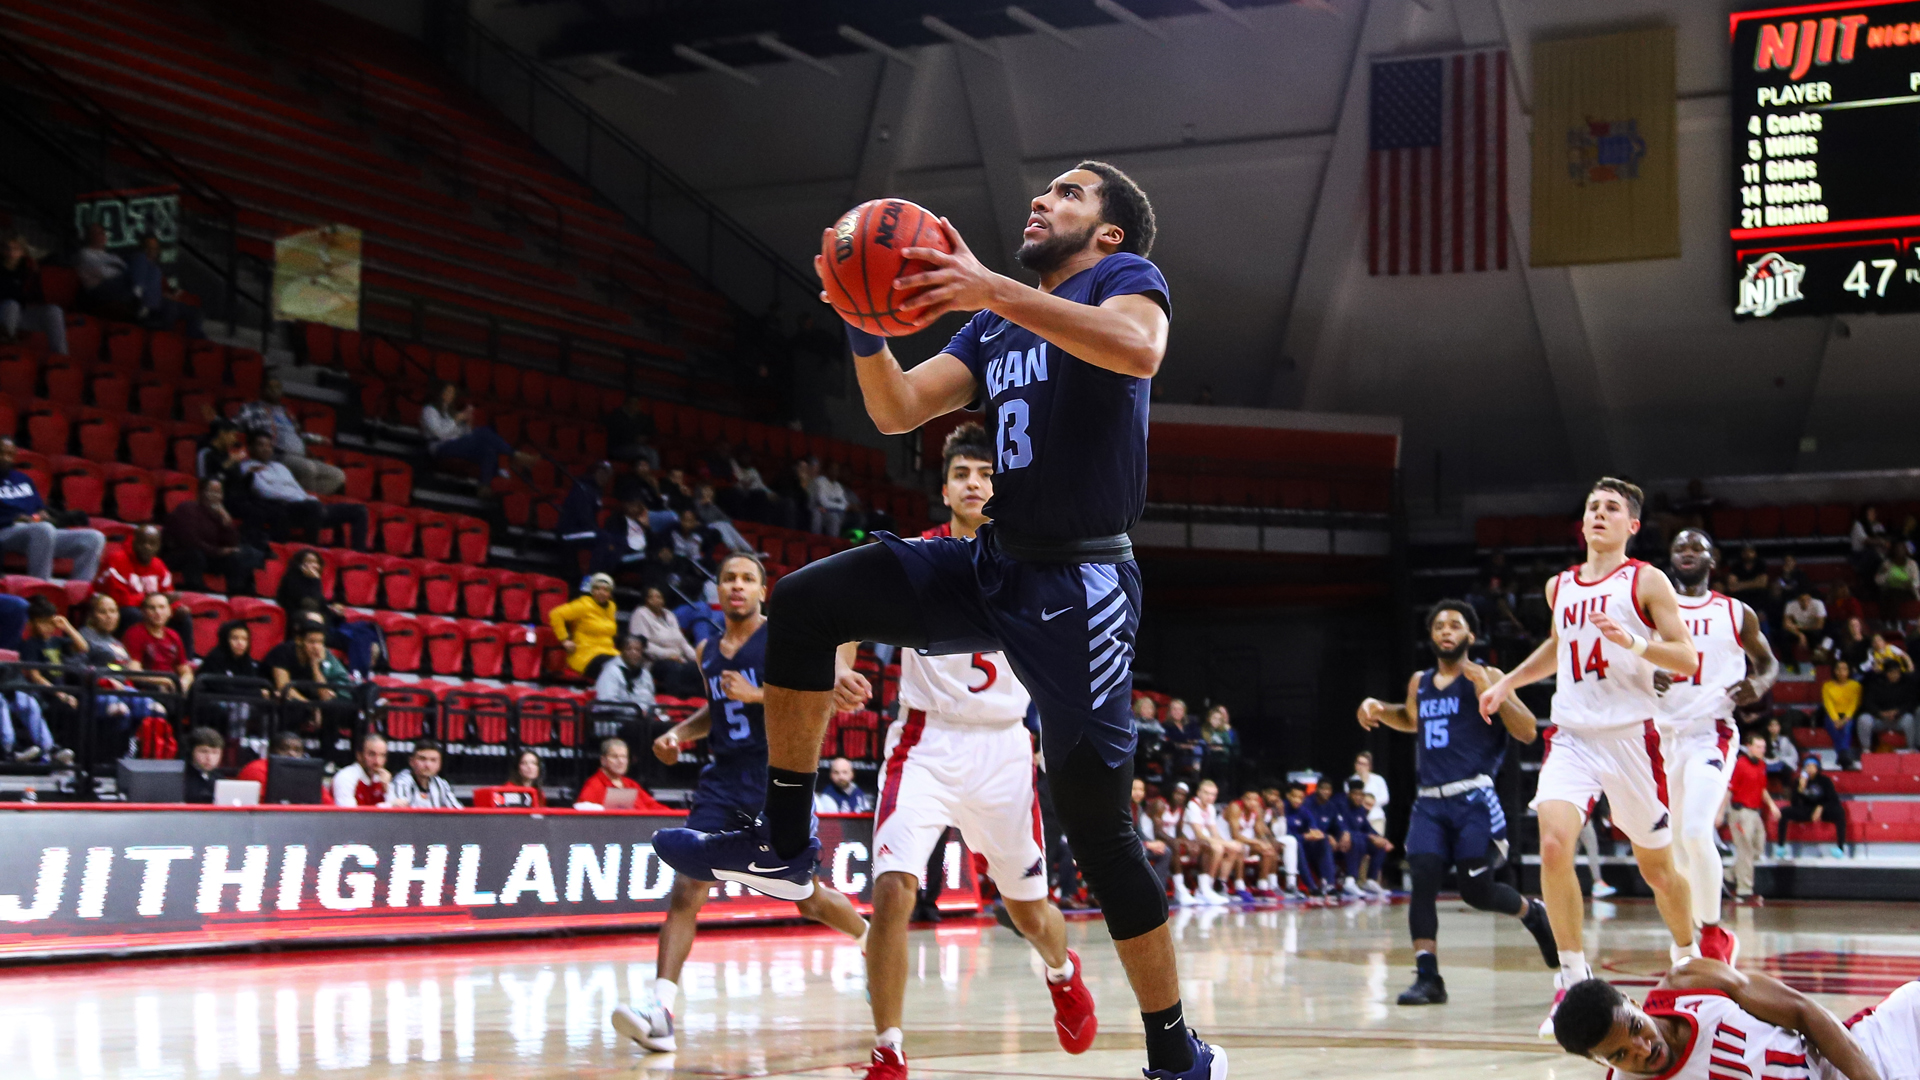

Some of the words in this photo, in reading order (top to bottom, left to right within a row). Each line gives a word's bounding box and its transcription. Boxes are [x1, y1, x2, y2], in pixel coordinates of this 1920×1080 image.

[1753, 14, 1868, 80] NJIT
[1757, 81, 1832, 107] PLAYER
[1747, 115, 1761, 136] 4
[1766, 111, 1822, 135] Cooks
[1748, 139, 1762, 160] 5
[1764, 134, 1818, 157] Willis
[1741, 163, 1760, 184] 11
[1765, 158, 1817, 182] Gibbs
[1740, 185, 1761, 206] 14
[1764, 180, 1822, 205] Walsh
[1741, 207, 1762, 229] 21
[1743, 271, 1799, 313] NJIT
[1843, 258, 1897, 298] 47
[996, 398, 1033, 474] 13
[1563, 594, 1612, 630] NJIT
[968, 651, 998, 693] 5
[1569, 637, 1609, 684] 14
[724, 700, 751, 740] 5
[1420, 696, 1460, 718] KEAN
[1424, 718, 1450, 750] 15
